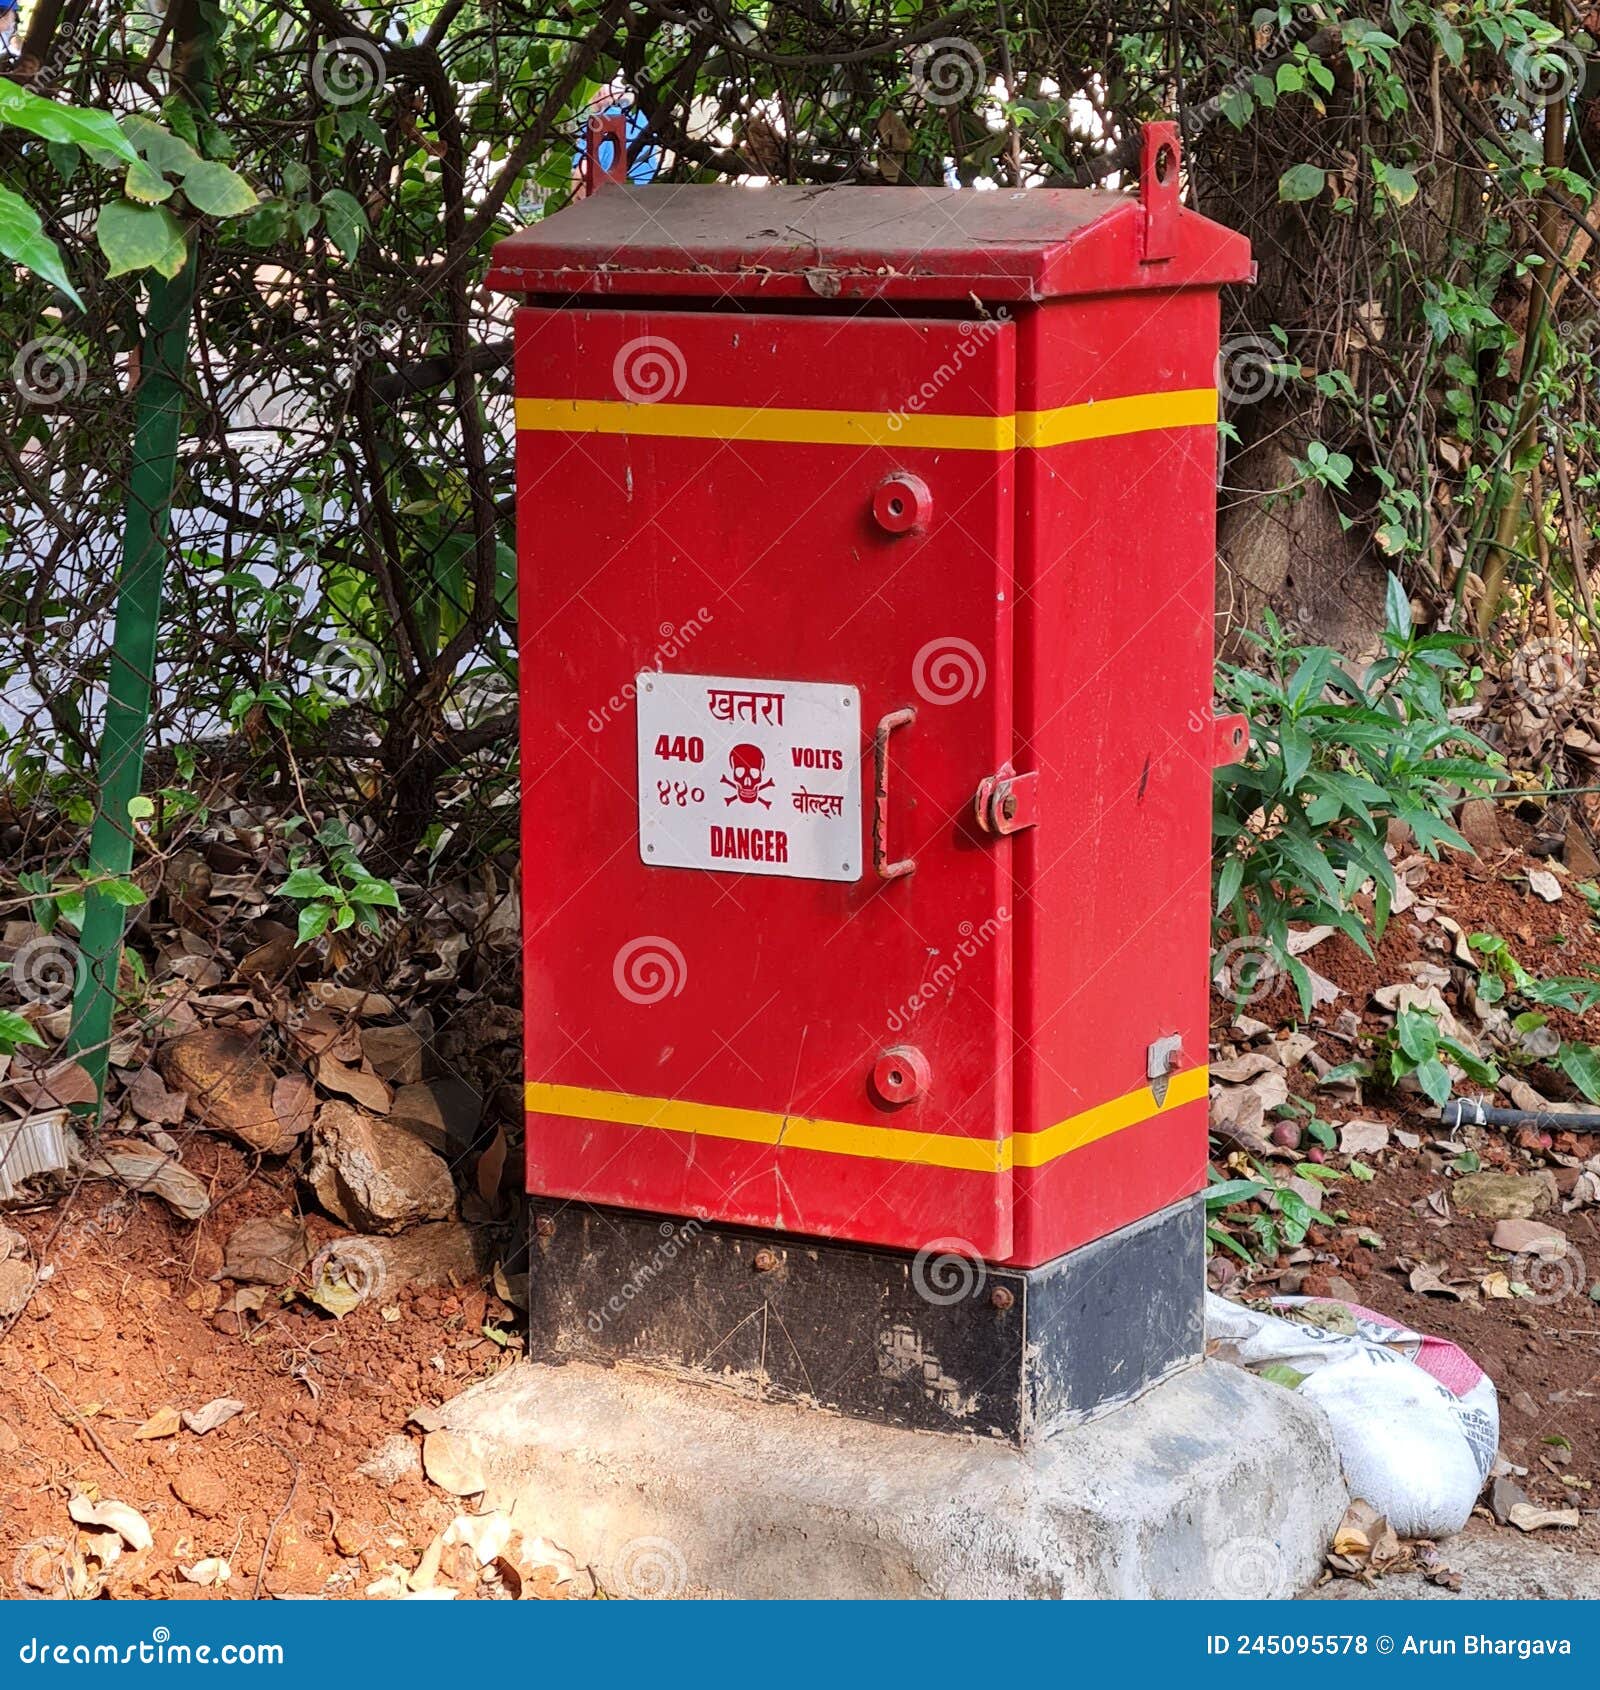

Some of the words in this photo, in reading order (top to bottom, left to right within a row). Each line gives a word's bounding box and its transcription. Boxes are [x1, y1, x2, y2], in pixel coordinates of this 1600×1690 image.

[707, 689, 785, 726] खतरा
[655, 734, 704, 763] 440
[791, 747, 843, 770] VOLTS
[657, 779, 704, 807] ४४०
[792, 785, 844, 819] वोल्ट्स
[710, 825, 788, 863] DANGER
